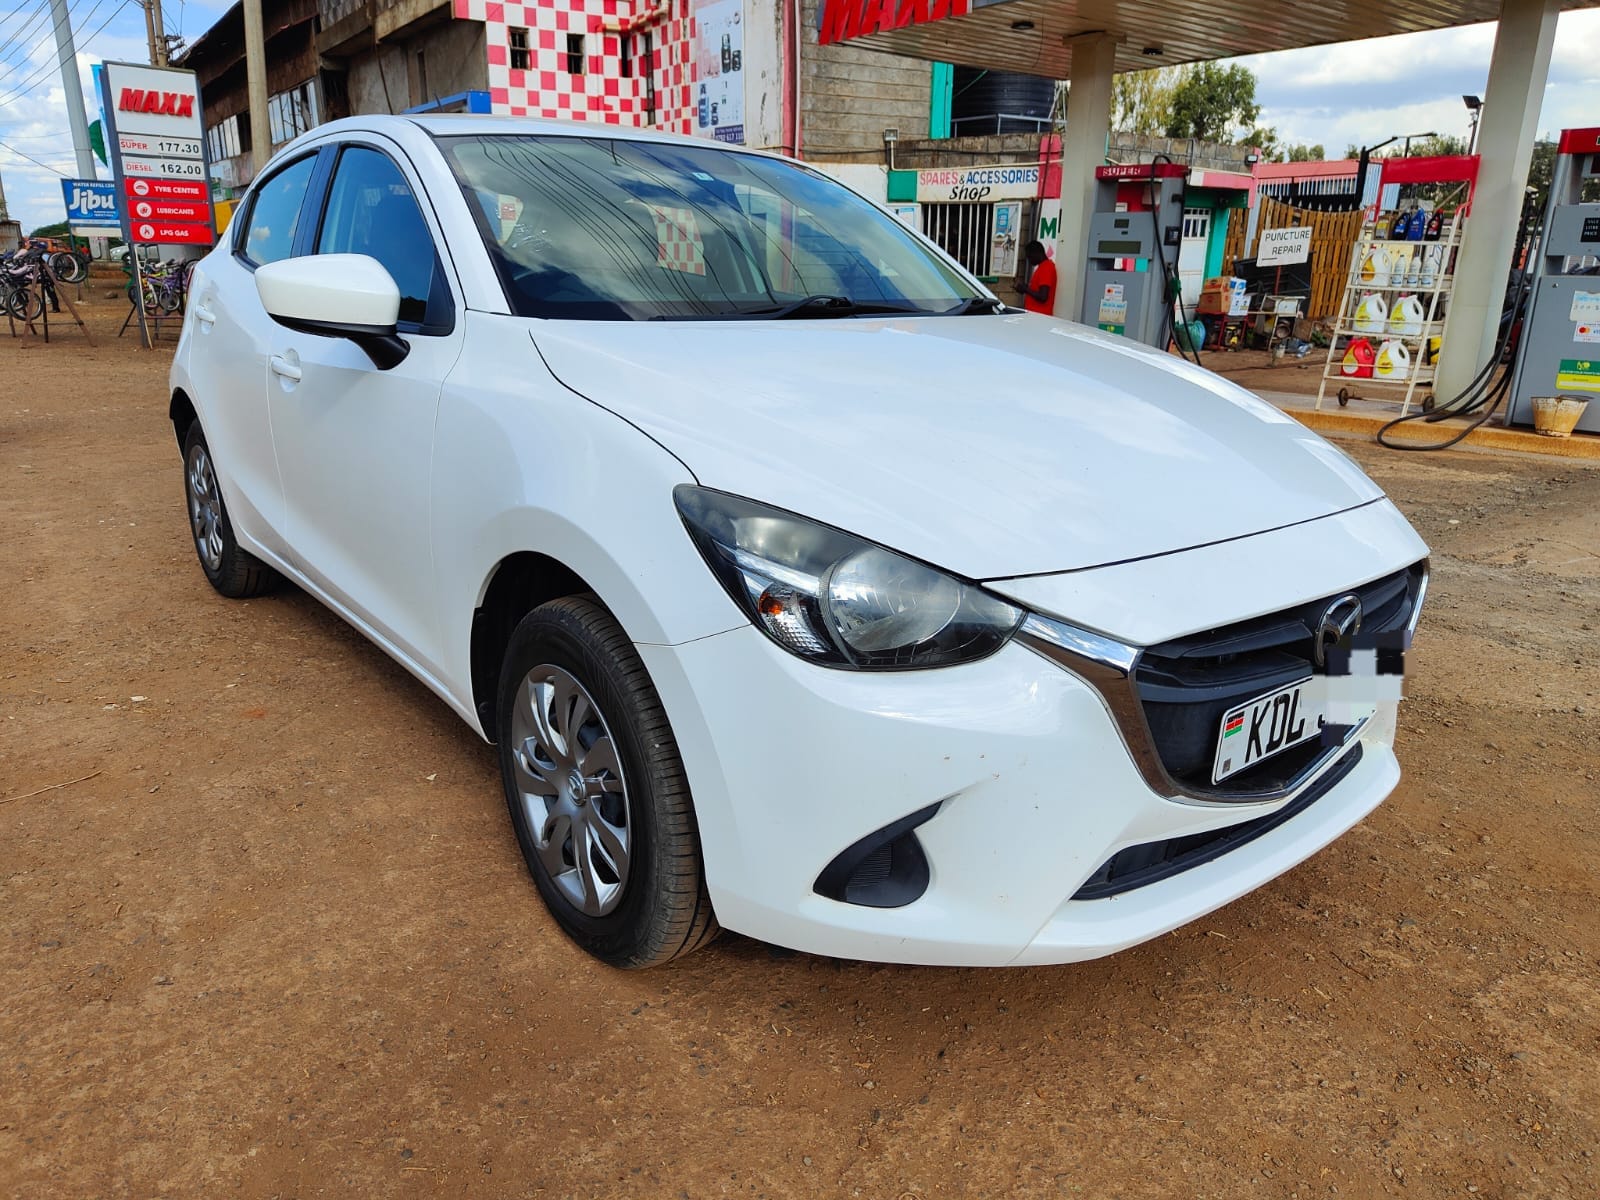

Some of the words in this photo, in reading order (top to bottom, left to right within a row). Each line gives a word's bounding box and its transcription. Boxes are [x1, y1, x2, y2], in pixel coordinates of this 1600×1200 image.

[119, 87, 195, 118] MAXX
[121, 141, 148, 150] SUPER
[158, 142, 200, 154] 177.30
[126, 163, 152, 172] DIESEL
[160, 163, 201, 175] 162.00
[920, 171, 959, 185] SPARES
[959, 175, 965, 185] &
[966, 169, 1039, 184] ACCESSORIES
[154, 185, 172, 193] TYRE
[69, 188, 115, 215] Jibu
[156, 207, 194, 215] LUBRICANTS
[1039, 217, 1057, 239] M
[1265, 230, 1310, 242] PUNCTURE
[1271, 244, 1302, 255] REPAIR
[1245, 689, 1305, 763] KDL
